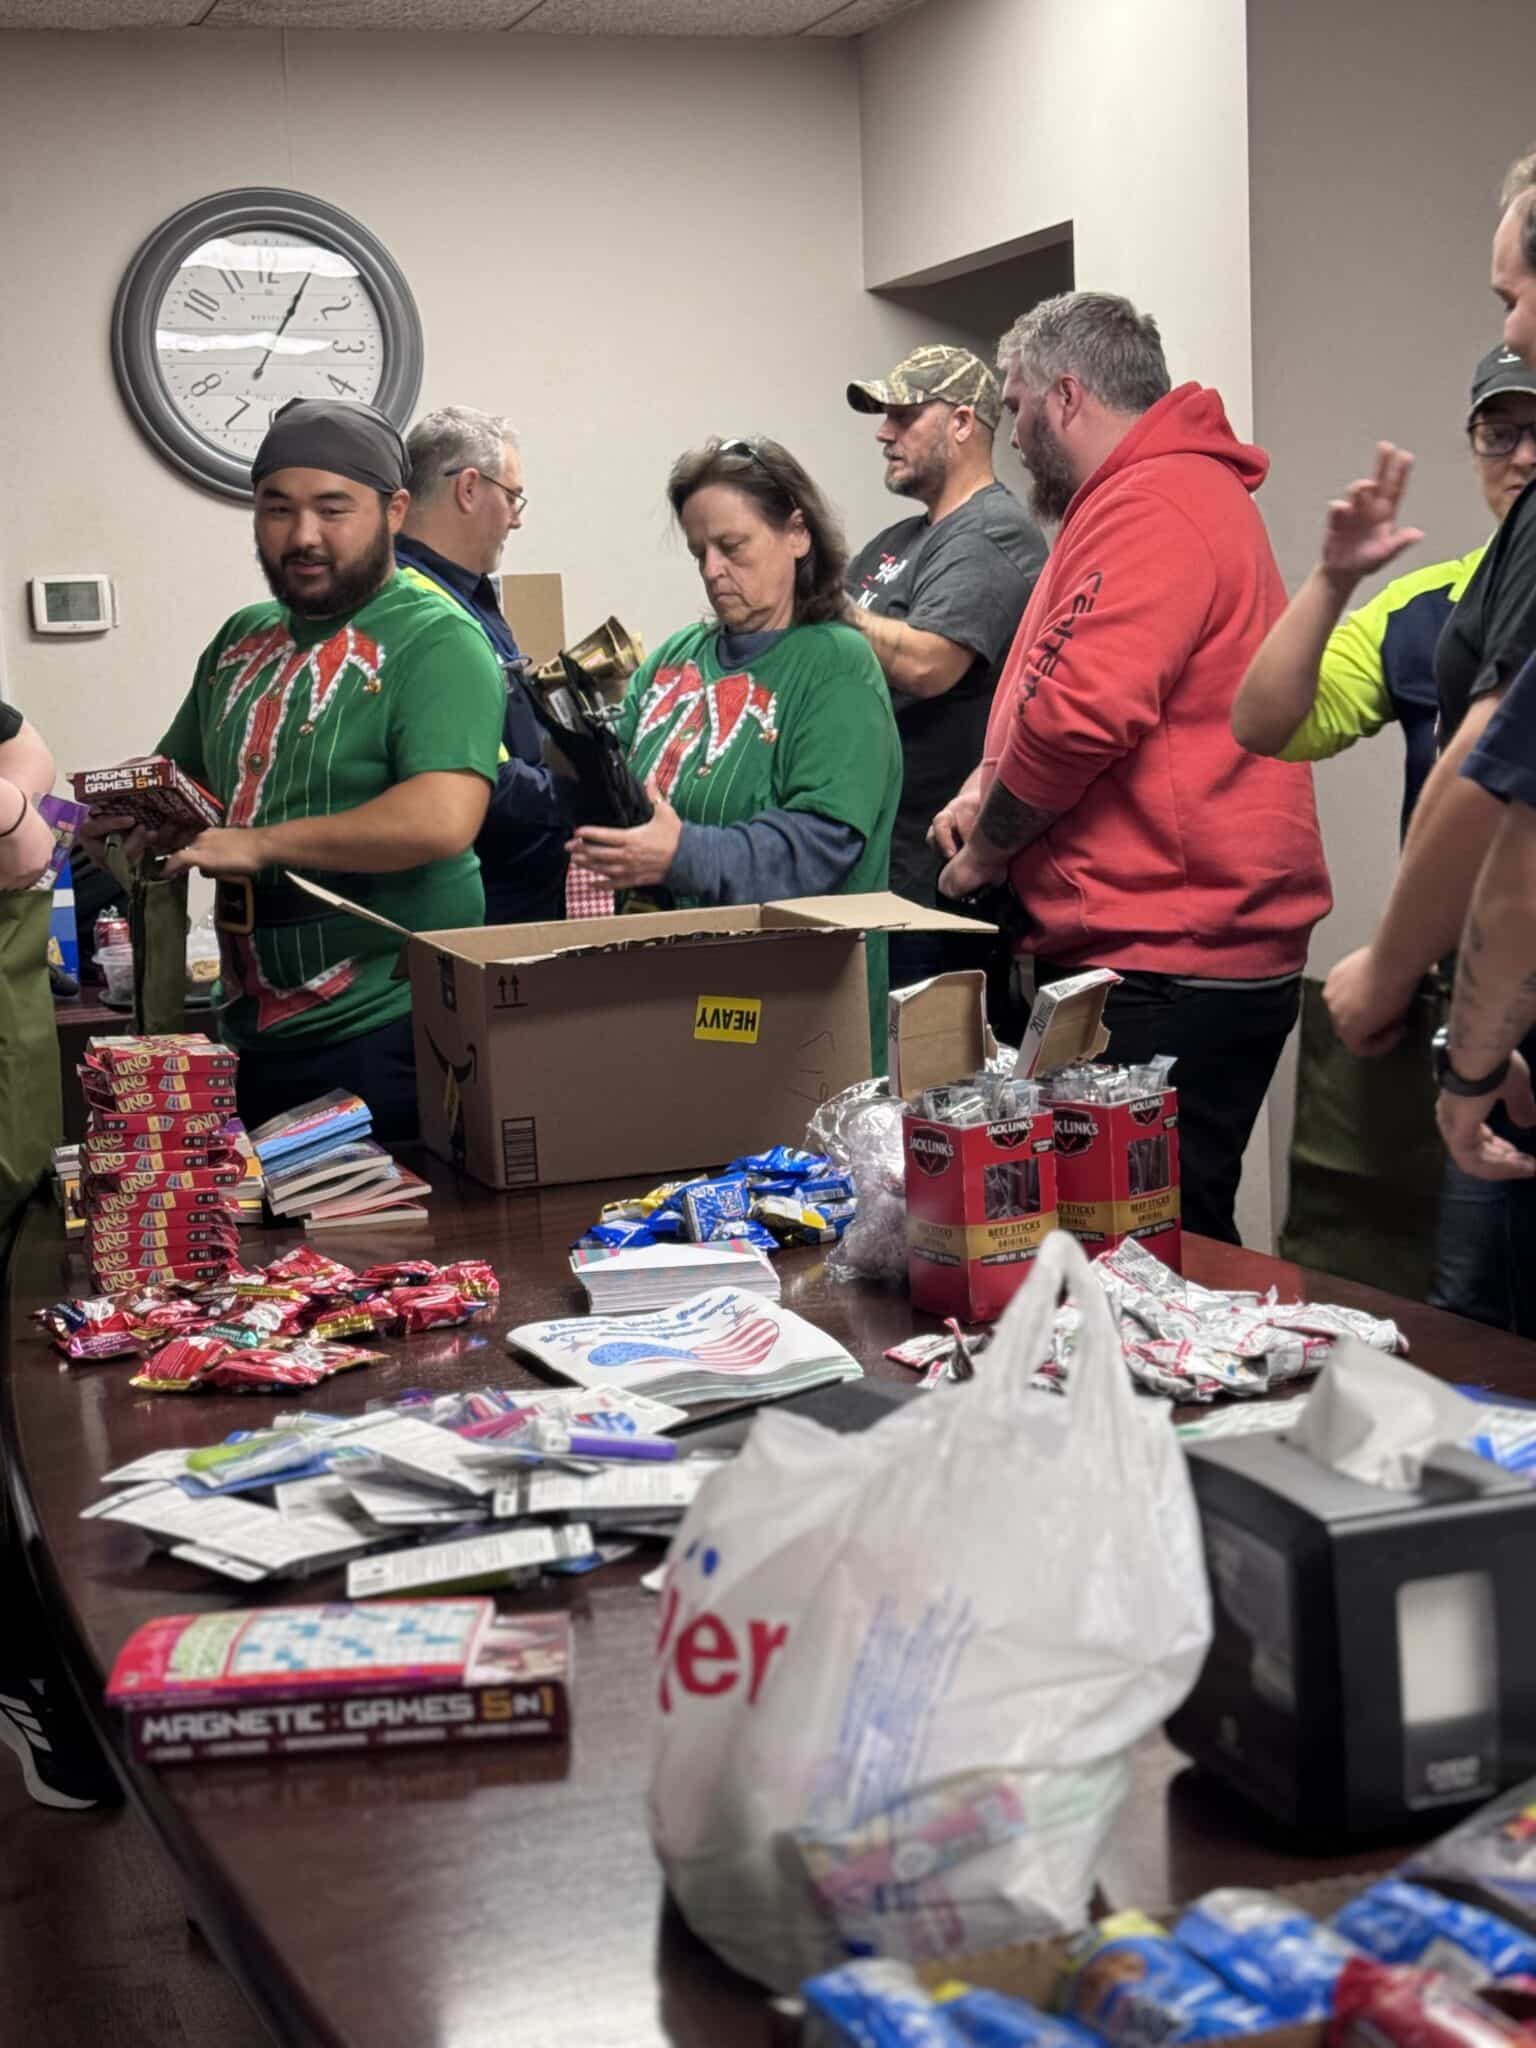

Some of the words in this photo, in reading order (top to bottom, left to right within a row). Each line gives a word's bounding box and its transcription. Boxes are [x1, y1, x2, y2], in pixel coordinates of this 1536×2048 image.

[184, 289, 220, 321] 10
[320, 296, 352, 320] 2
[332, 340, 366, 353] 3
[191, 373, 222, 397] 8
[327, 374, 357, 395] 4
[225, 395, 251, 428] 7
[85, 766, 152, 783] MAGNETIC
[85, 779, 133, 793] GAMES
[697, 1008, 756, 1032] HEAVY
[1030, 1015, 1048, 1036] 20
[115, 1055, 151, 1075] UNO
[111, 1075, 147, 1095] UNO
[118, 1093, 152, 1113] UNO
[186, 1113, 220, 1133] UNO
[985, 1124, 1009, 1136] JACK
[909, 1136, 928, 1152] JACK
[90, 1153, 125, 1174] UNO
[120, 1173, 156, 1193] UNO
[93, 1212, 128, 1233] UNO
[1011, 1219, 1040, 1234] STICKS
[93, 1232, 128, 1253] UNO
[93, 1252, 128, 1273] UNO
[102, 1271, 136, 1292] UNO
[141, 1703, 326, 1745] MAGNETIC
[344, 1692, 475, 1729] GAMES
